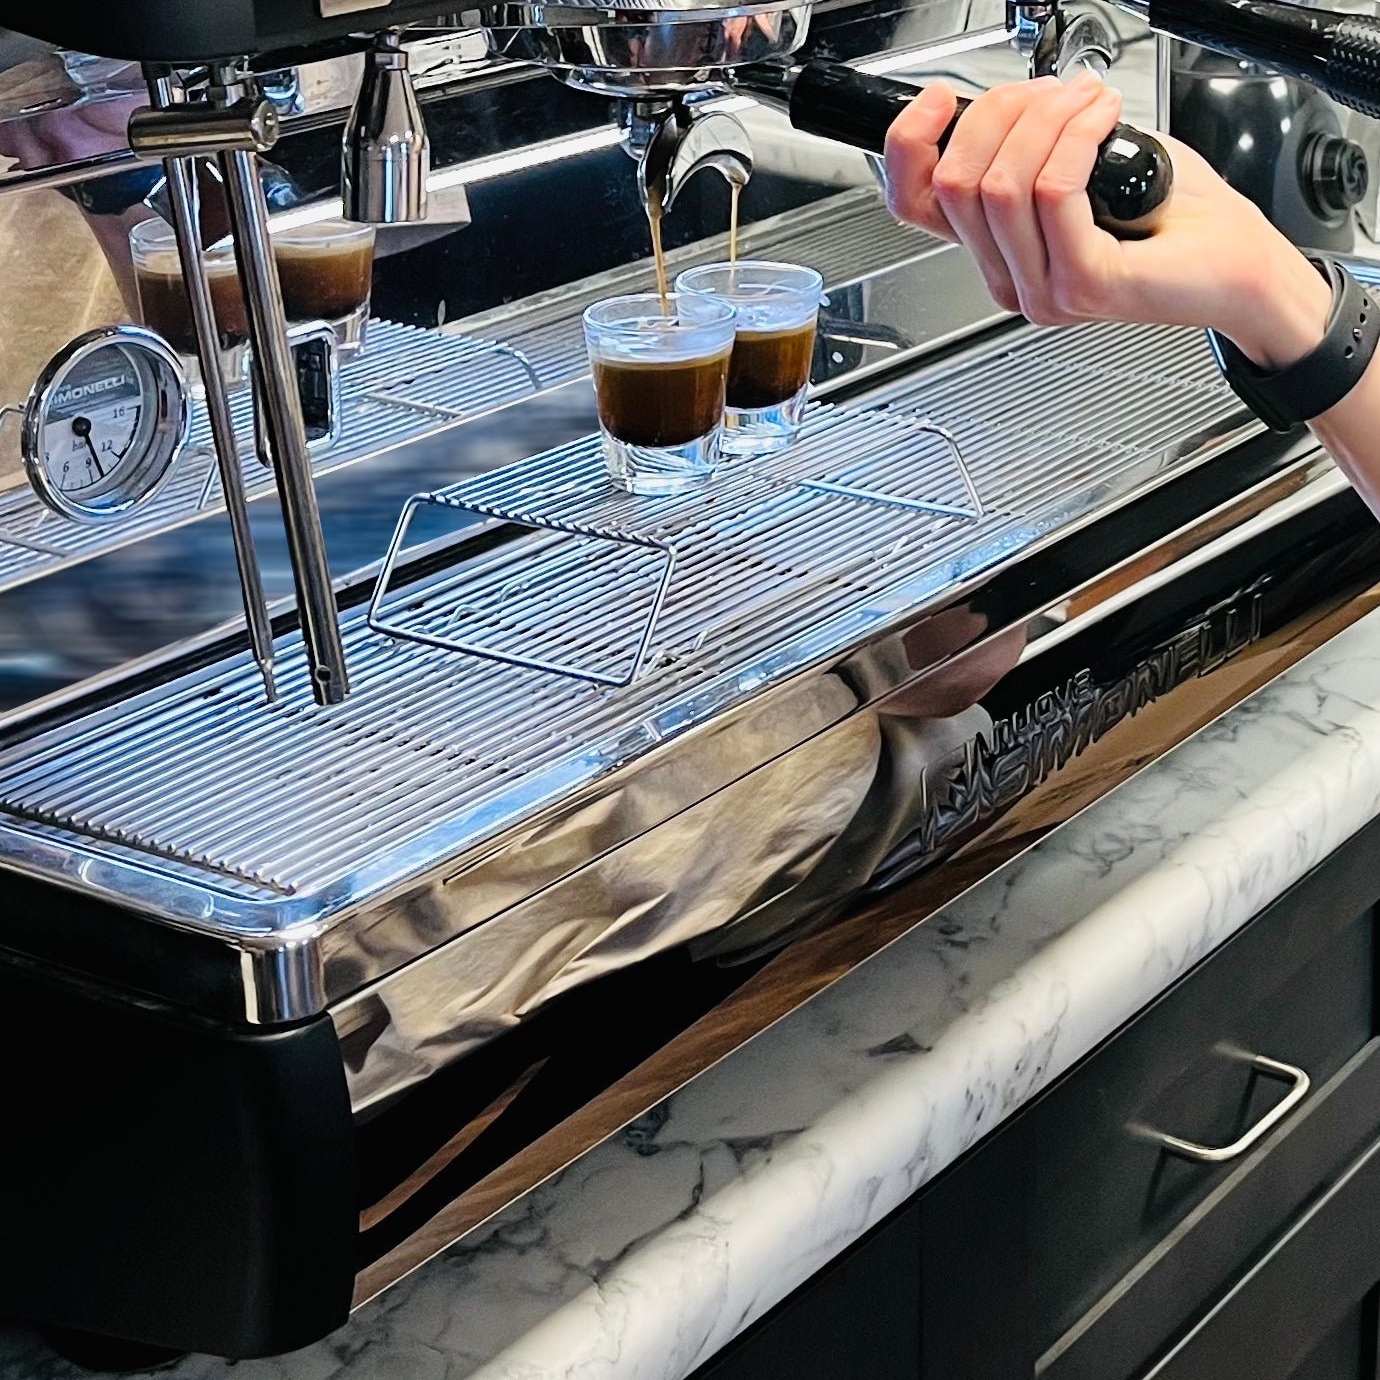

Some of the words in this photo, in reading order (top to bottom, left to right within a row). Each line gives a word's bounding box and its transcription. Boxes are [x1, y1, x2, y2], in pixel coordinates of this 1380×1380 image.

[51, 374, 125, 405] IMONELLI
[112, 406, 125, 419] 16
[101, 439, 113, 452] 12
[63, 460, 70, 473] 6
